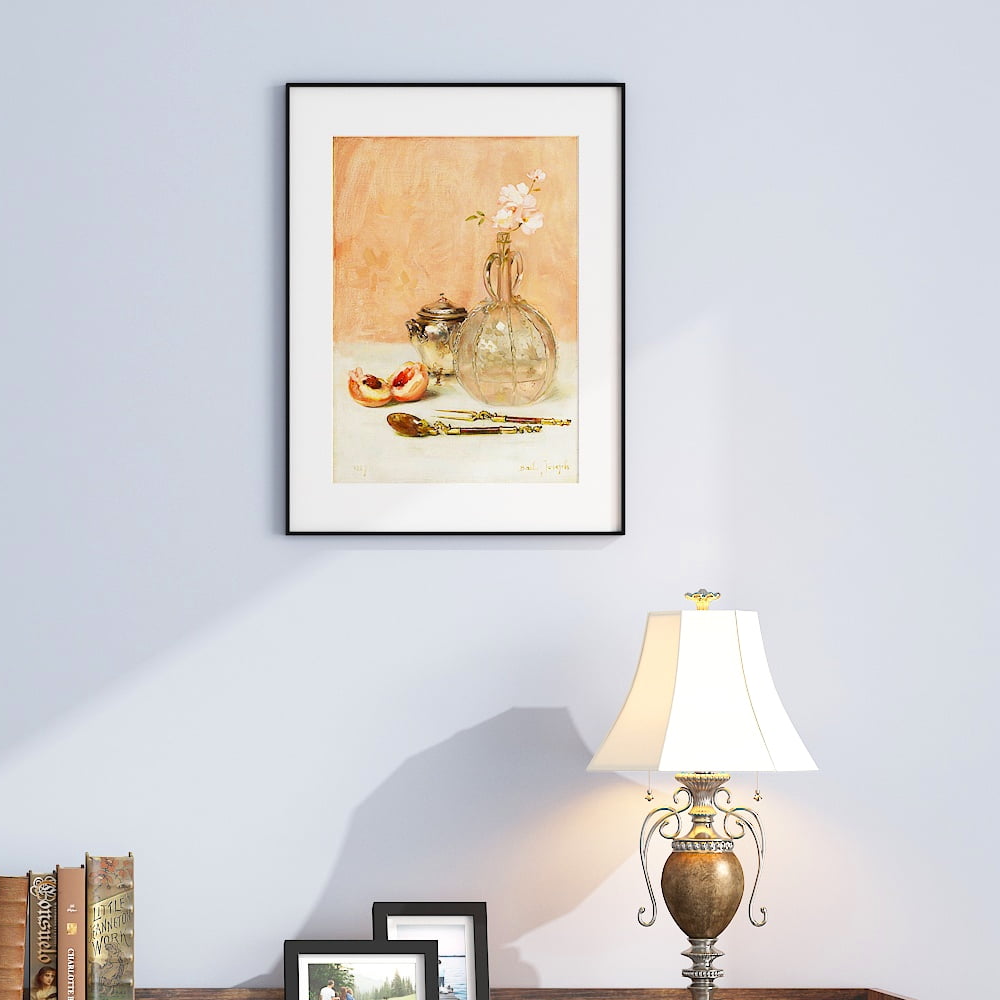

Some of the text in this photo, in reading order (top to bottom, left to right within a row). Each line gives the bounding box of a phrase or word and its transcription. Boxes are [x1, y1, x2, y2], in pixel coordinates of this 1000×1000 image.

[30, 876, 56, 964] Consuelo
[93, 898, 125, 921] LITTLE
[91, 931, 130, 957] WORK
[67, 947, 76, 995] CHARLOTTE
